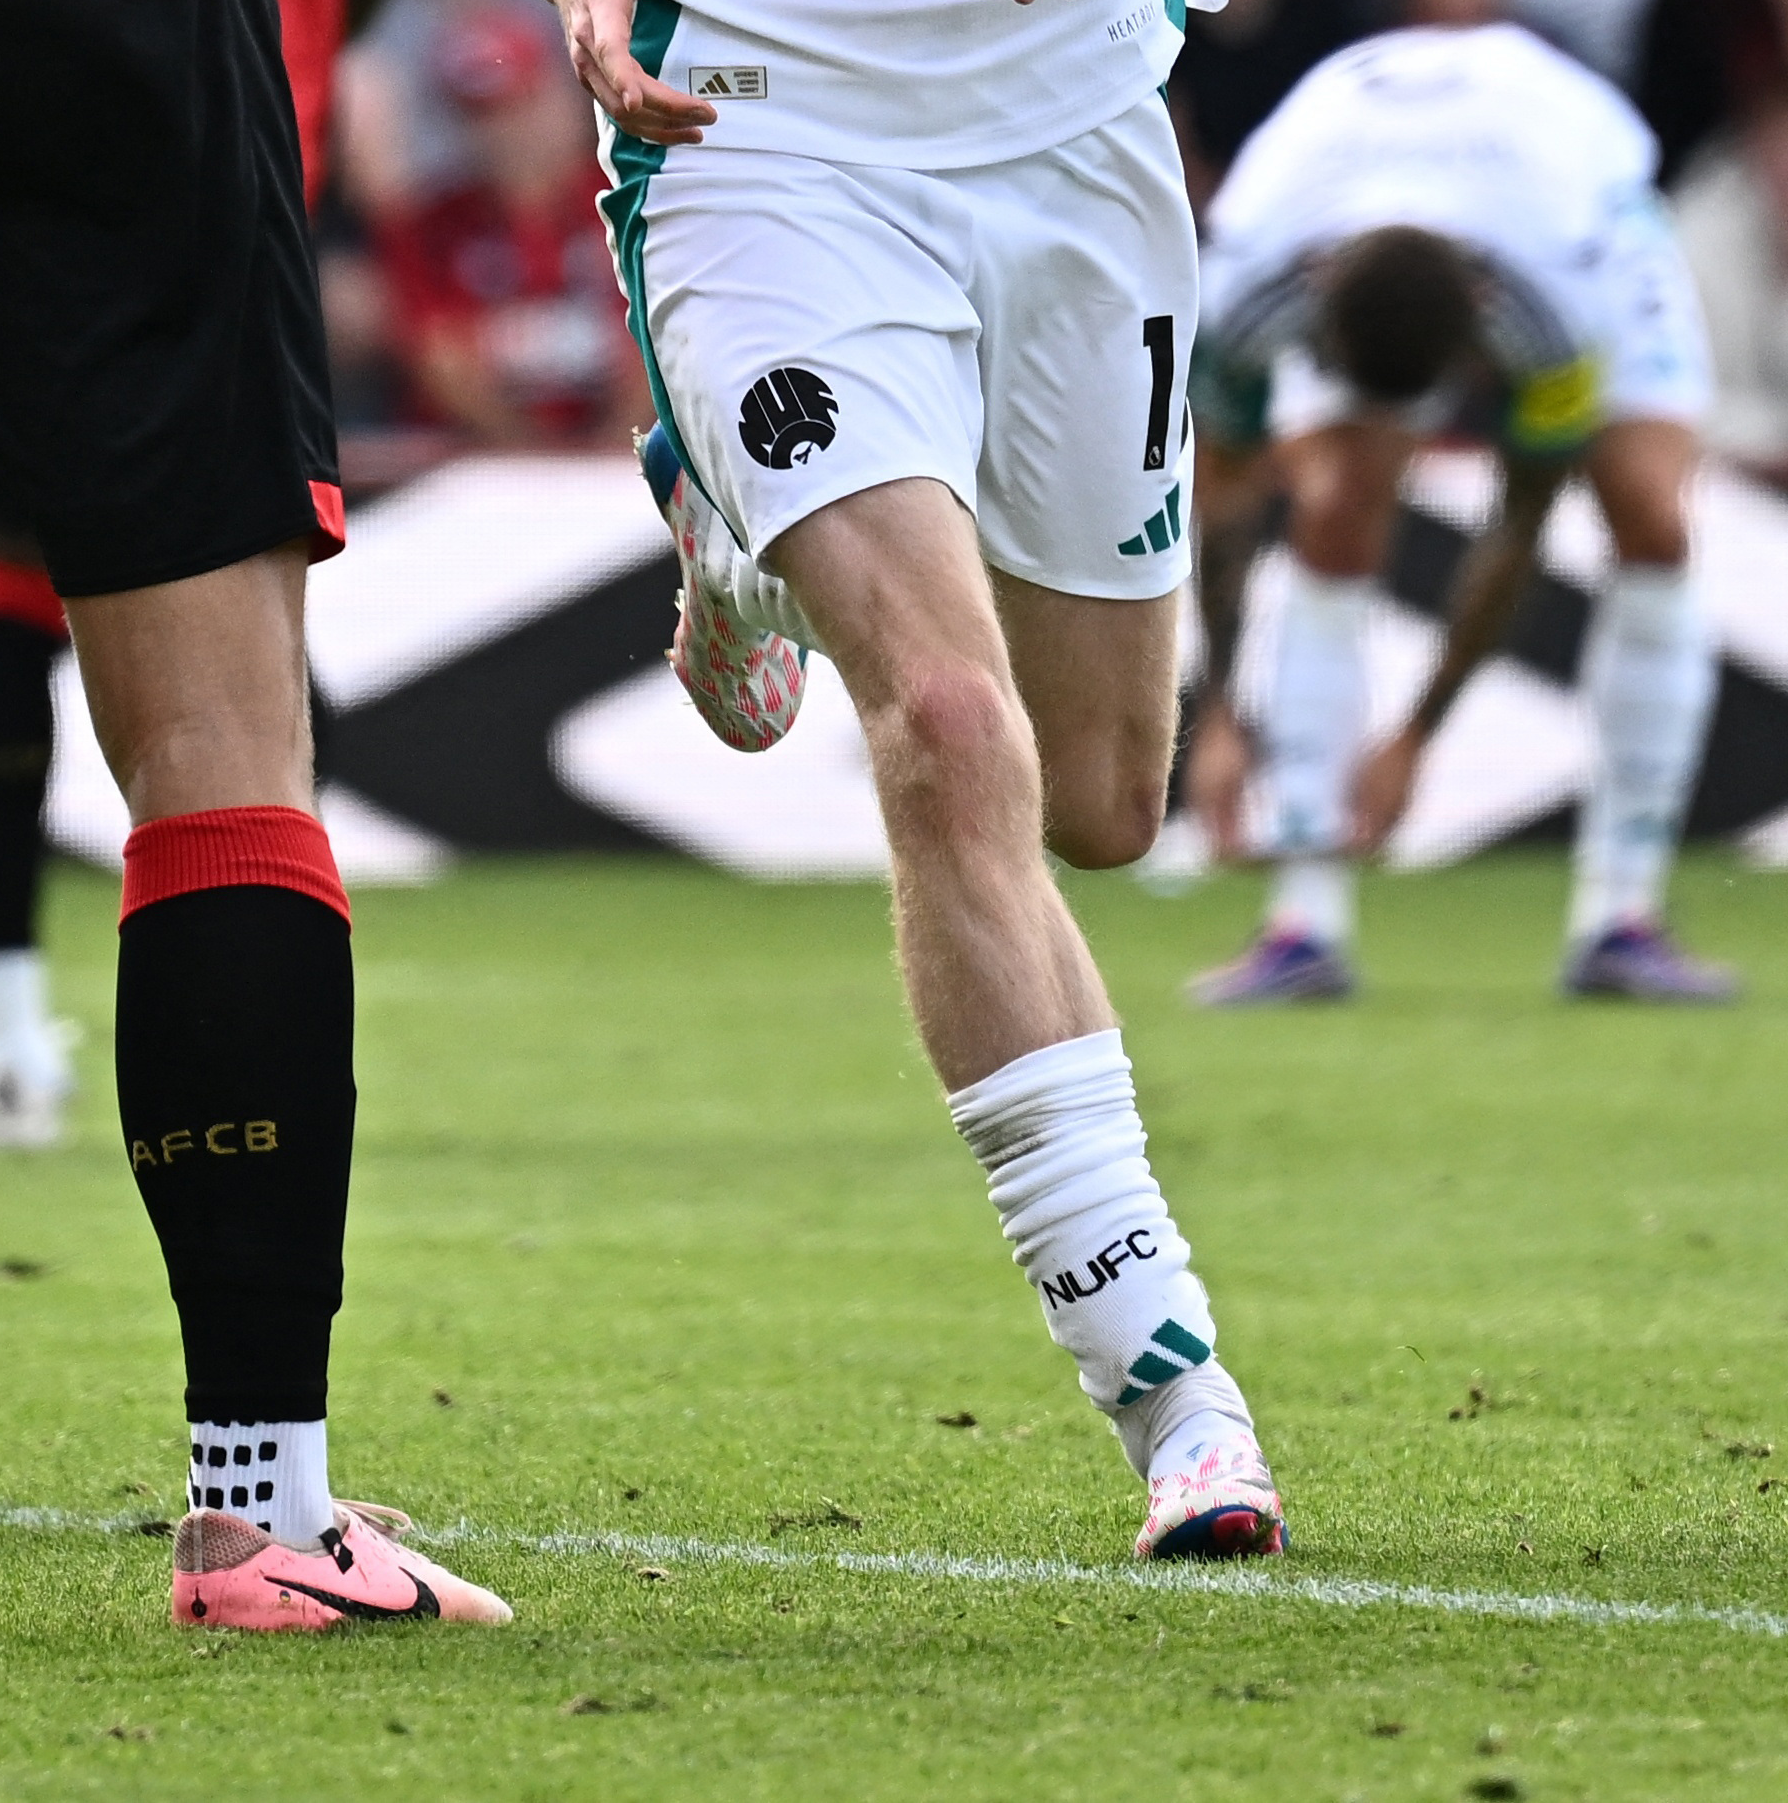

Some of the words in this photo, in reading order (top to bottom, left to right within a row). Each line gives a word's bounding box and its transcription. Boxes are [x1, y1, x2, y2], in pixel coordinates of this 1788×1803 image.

[1143, 315, 1189, 471] 1
[131, 1119, 278, 1172] AFCB
[1042, 1229, 1158, 1310] NUFC
